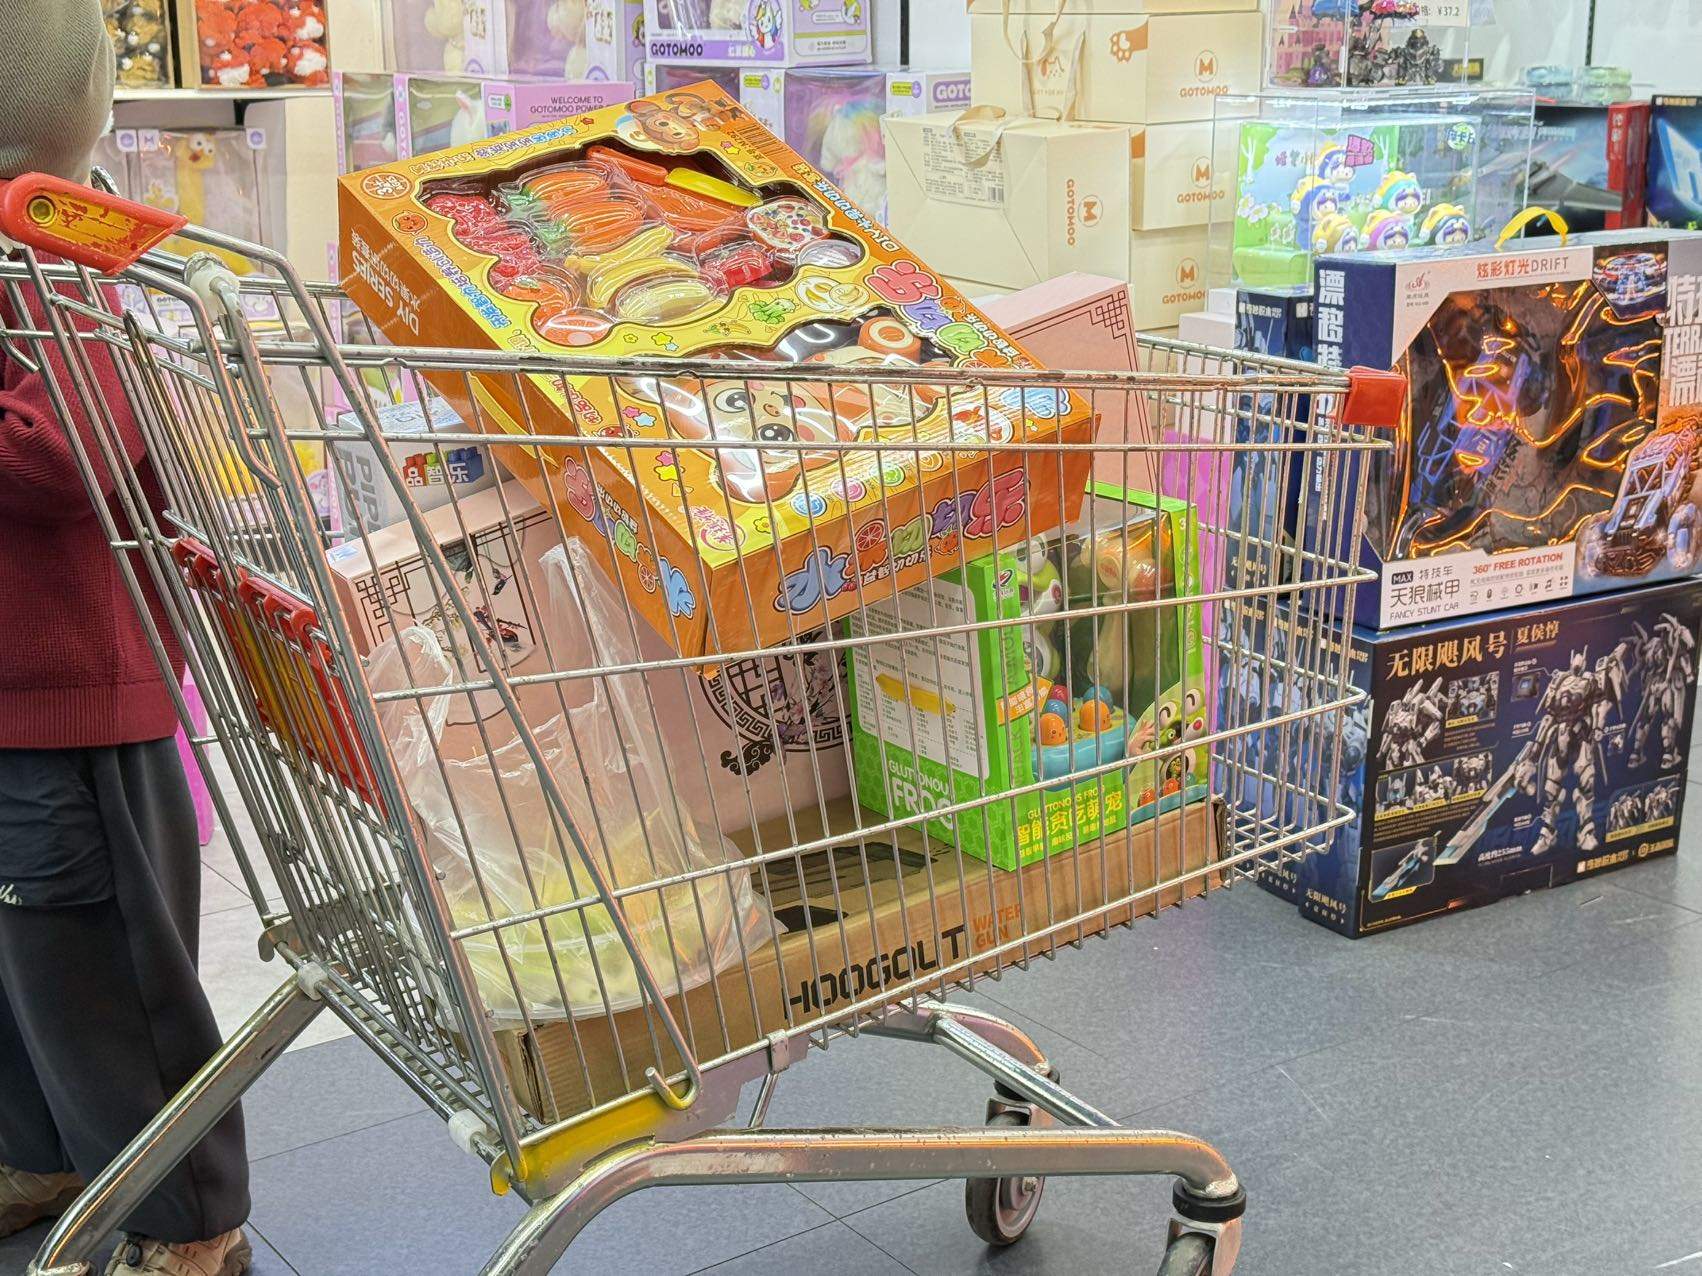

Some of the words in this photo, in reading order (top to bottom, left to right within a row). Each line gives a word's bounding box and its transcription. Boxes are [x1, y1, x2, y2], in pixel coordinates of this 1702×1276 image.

[651, 42, 704, 57] GOTOMOO
[551, 96, 588, 104] WELCOME
[593, 96, 603, 104] TO
[1180, 85, 1229, 97] GOTOMOO
[531, 105, 574, 114] GOTOMOO
[1177, 190, 1225, 204] GOTOMOO
[1065, 179, 1076, 247] GOTOMOO
[1493, 560, 1517, 571] FREE
[1518, 552, 1563, 568] ROTATION
[1393, 573, 1412, 585] MAX
[1419, 565, 1453, 580] 特技车
[1390, 579, 1460, 608] 天狼械甲
[1390, 609, 1414, 621] FANCY
[1417, 604, 1441, 616] STUNT
[1444, 602, 1459, 611] CAR
[1385, 631, 1507, 681] 无限飓风号
